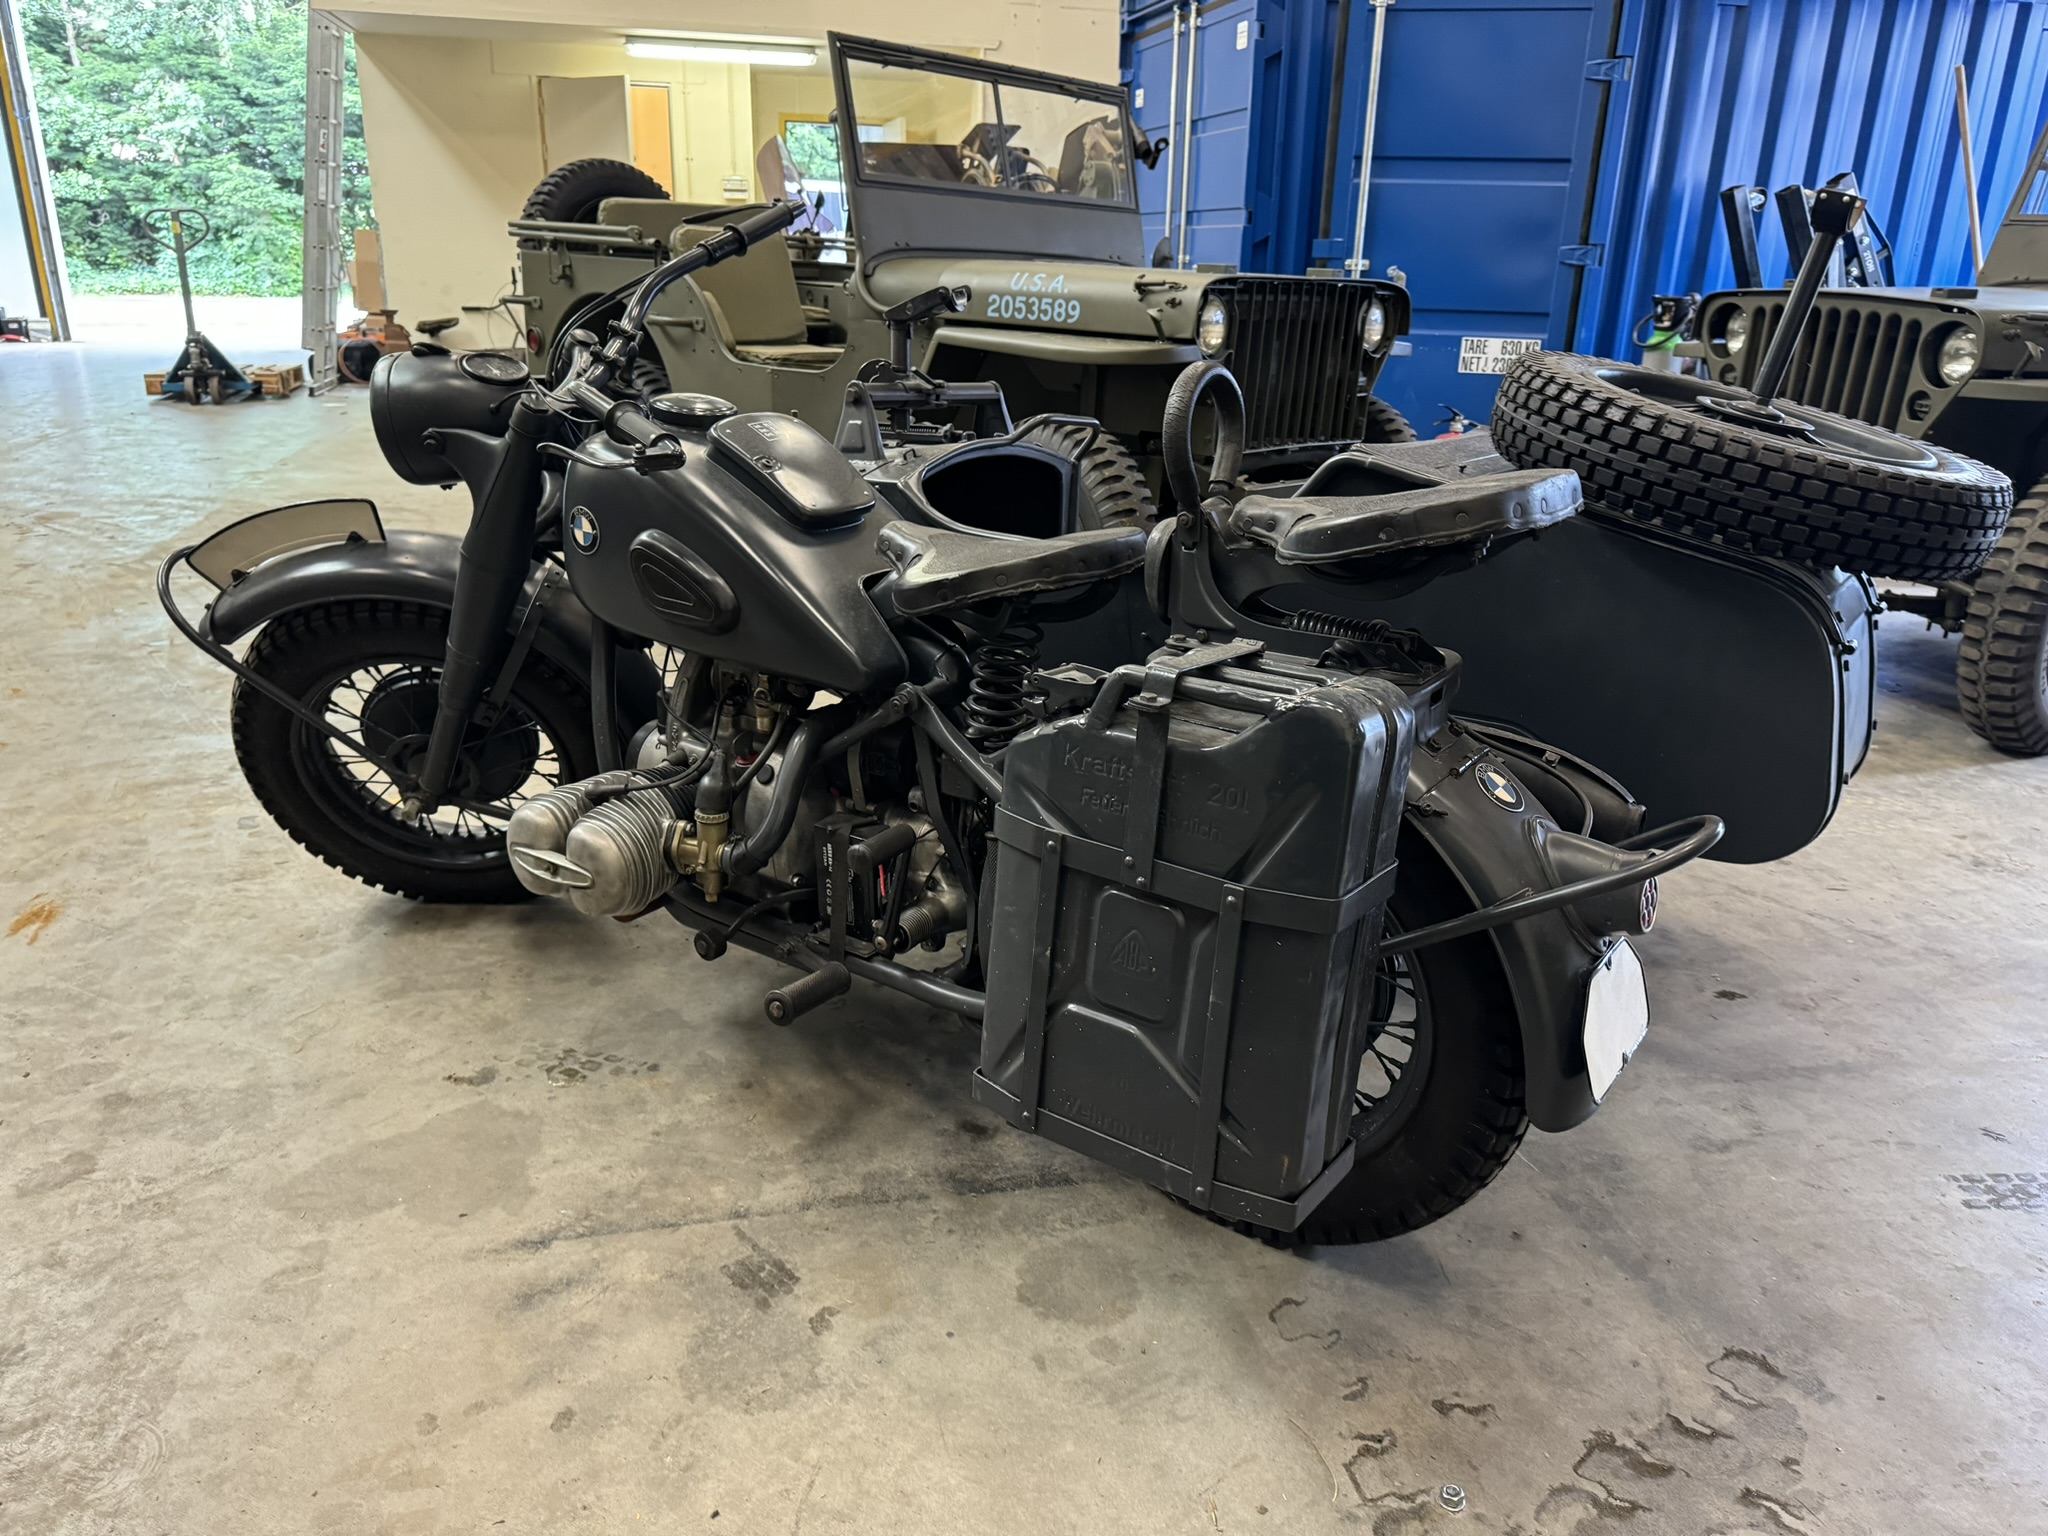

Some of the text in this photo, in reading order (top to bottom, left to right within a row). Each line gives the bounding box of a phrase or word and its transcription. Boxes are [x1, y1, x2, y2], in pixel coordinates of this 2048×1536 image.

[1010, 272, 1069, 294] U.S.A.
[986, 294, 1081, 324] 2053589
[1463, 338, 1488, 355] TARE
[1500, 340, 1522, 356] 630
[573, 508, 592, 520] BMW
[1477, 764, 1494, 780] BMW
